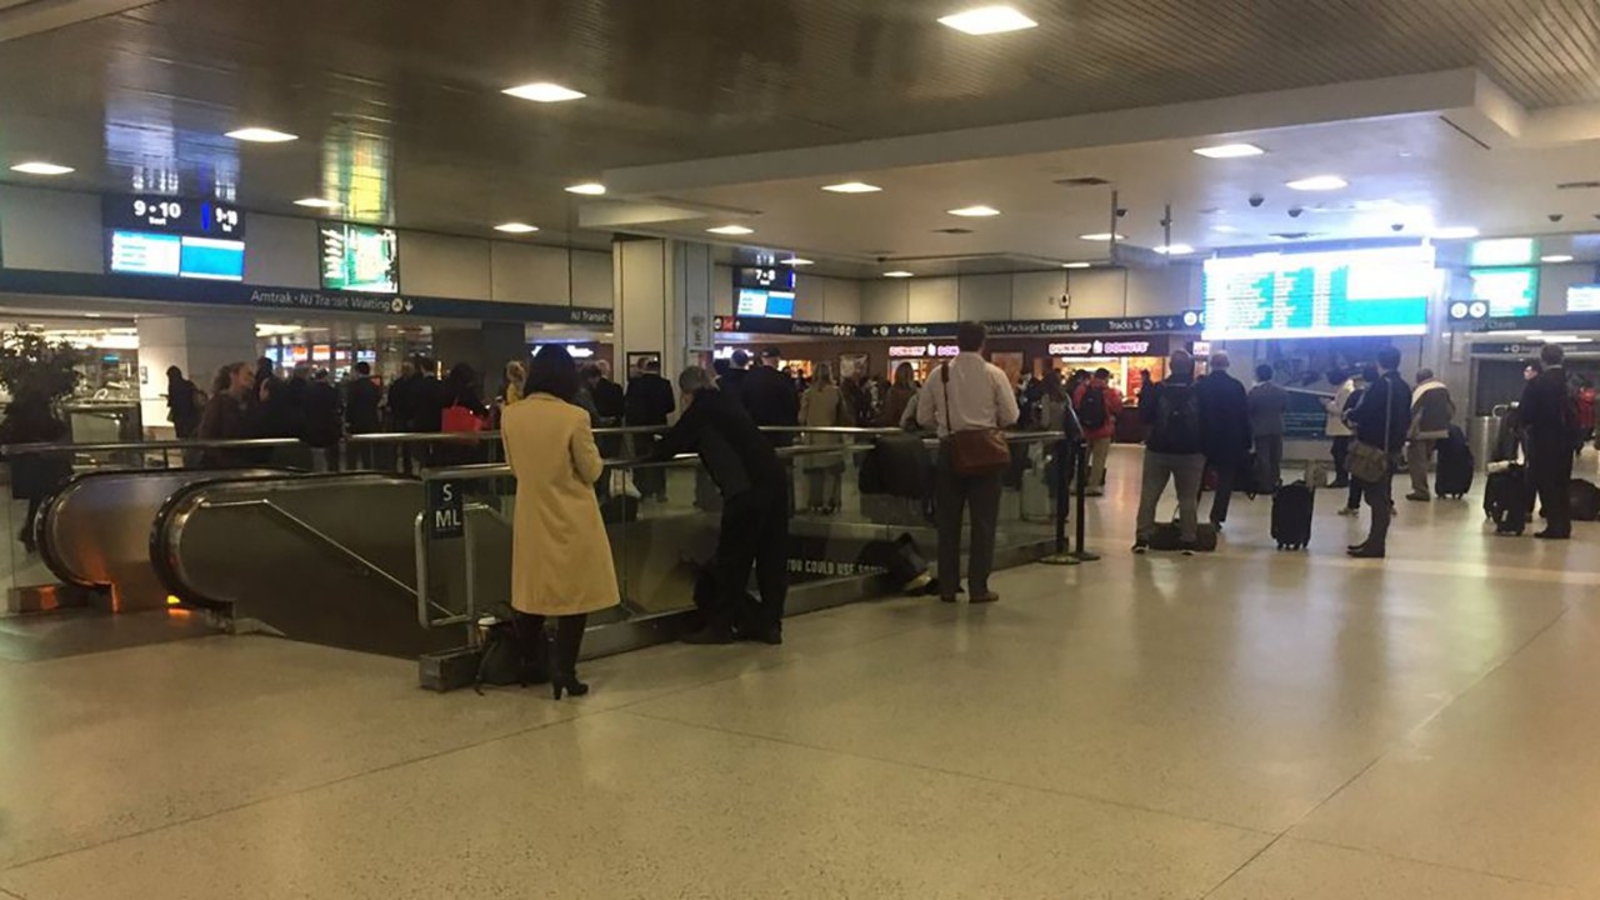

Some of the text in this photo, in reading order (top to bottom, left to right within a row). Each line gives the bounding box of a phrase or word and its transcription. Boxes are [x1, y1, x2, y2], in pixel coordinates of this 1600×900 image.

[133, 200, 181, 218] 9 10
[250, 289, 292, 304] Amtrak
[1104, 342, 1149, 354] DONUTS
[443, 483, 452, 501] S
[436, 510, 461, 527] ML
